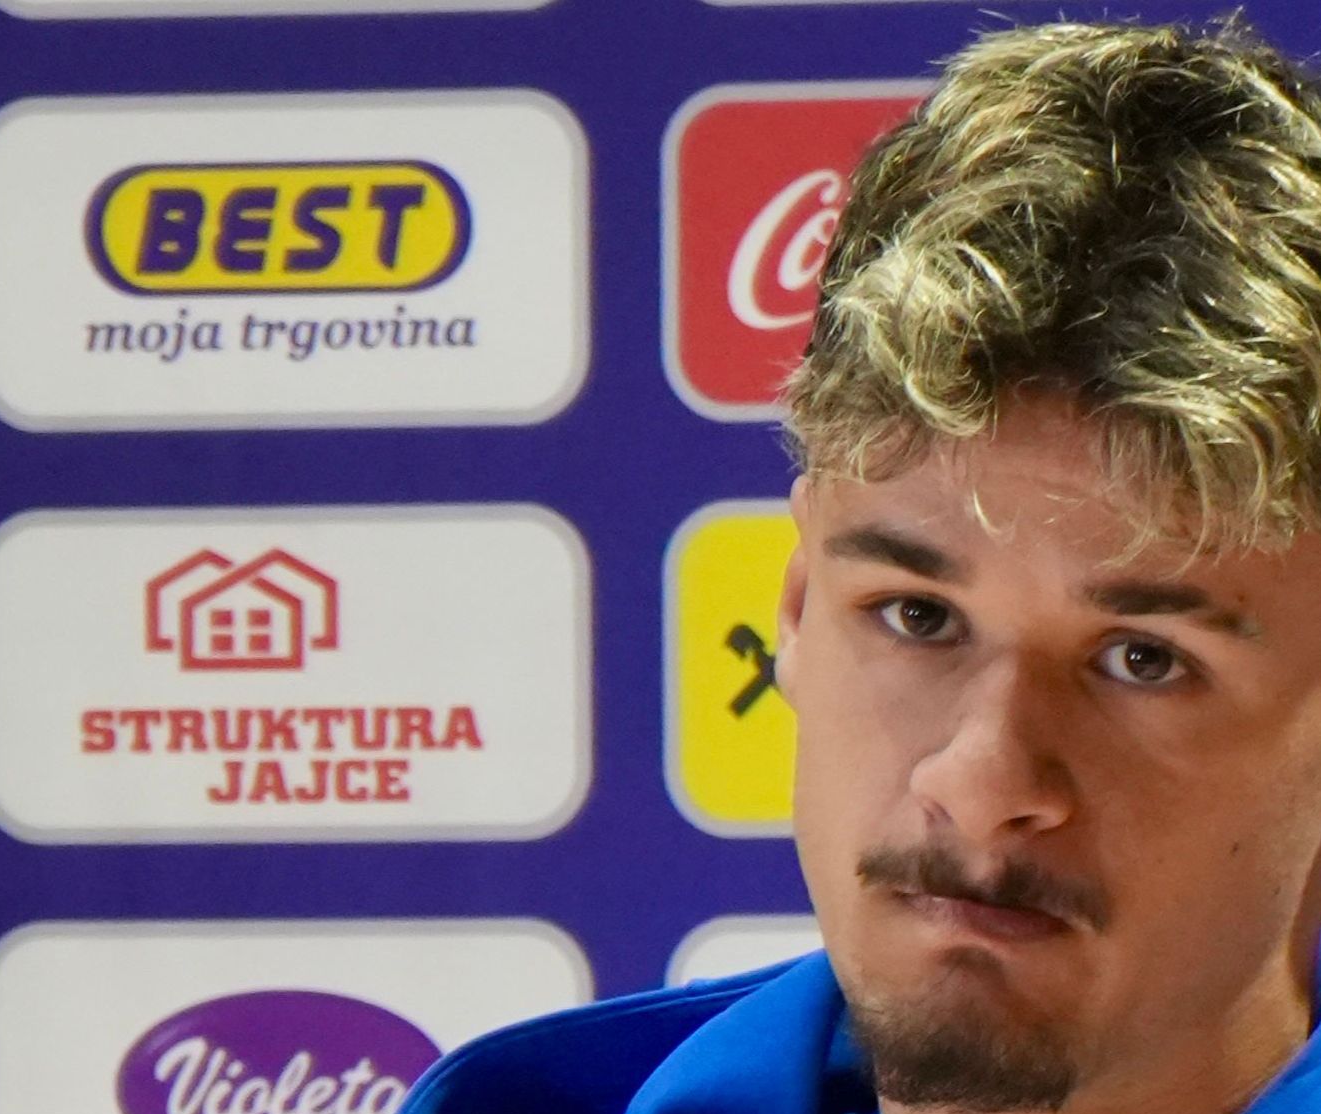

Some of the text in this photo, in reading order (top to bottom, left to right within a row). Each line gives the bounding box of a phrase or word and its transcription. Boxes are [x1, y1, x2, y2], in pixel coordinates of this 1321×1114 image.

[135, 182, 426, 275] BEST
[85, 304, 477, 362] moja trgovina
[80, 706, 484, 753] STRUKTURA
[207, 760, 411, 804] JAJCE
